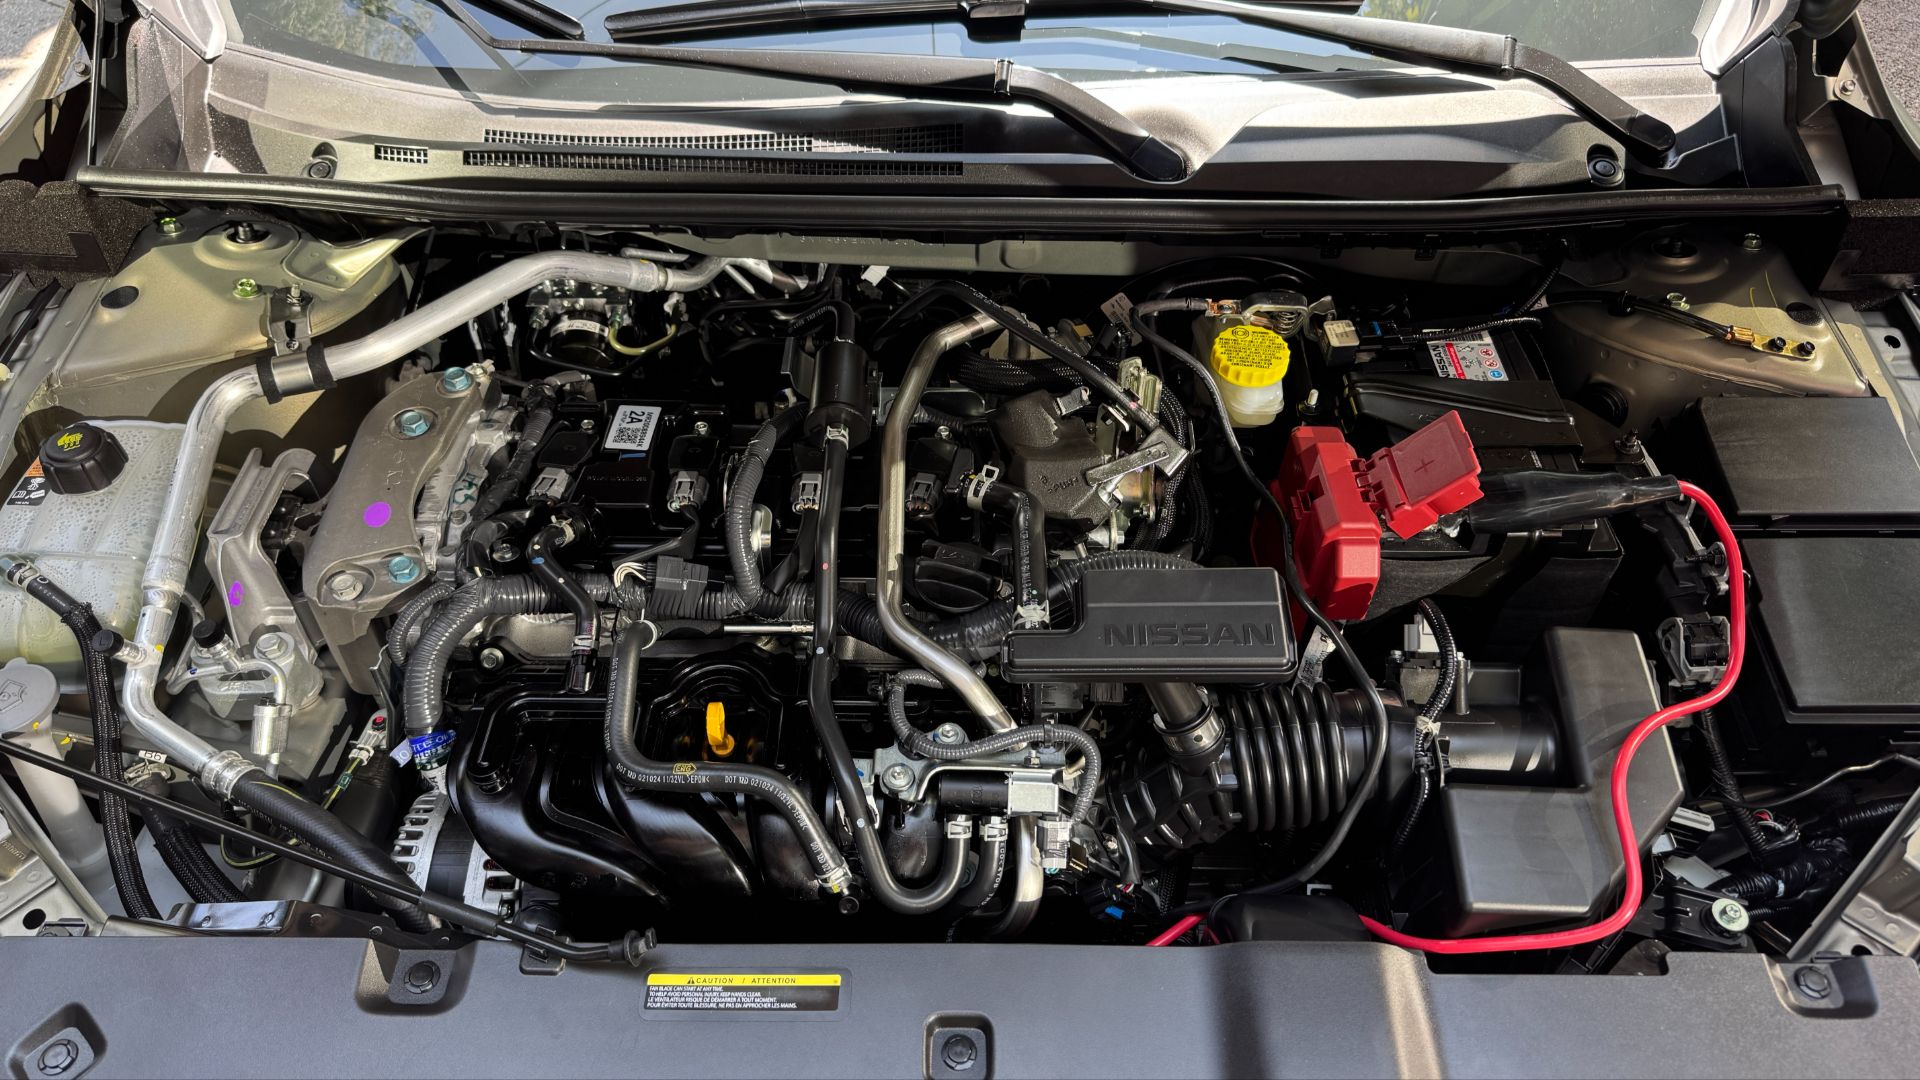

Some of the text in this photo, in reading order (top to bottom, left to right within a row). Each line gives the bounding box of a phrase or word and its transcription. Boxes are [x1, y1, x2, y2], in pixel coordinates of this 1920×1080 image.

[626, 410, 645, 424] 2A
[1103, 623, 1277, 647] NISSAN
[696, 977, 734, 985] CAUTION
[751, 977, 797, 985] ATTENTION
